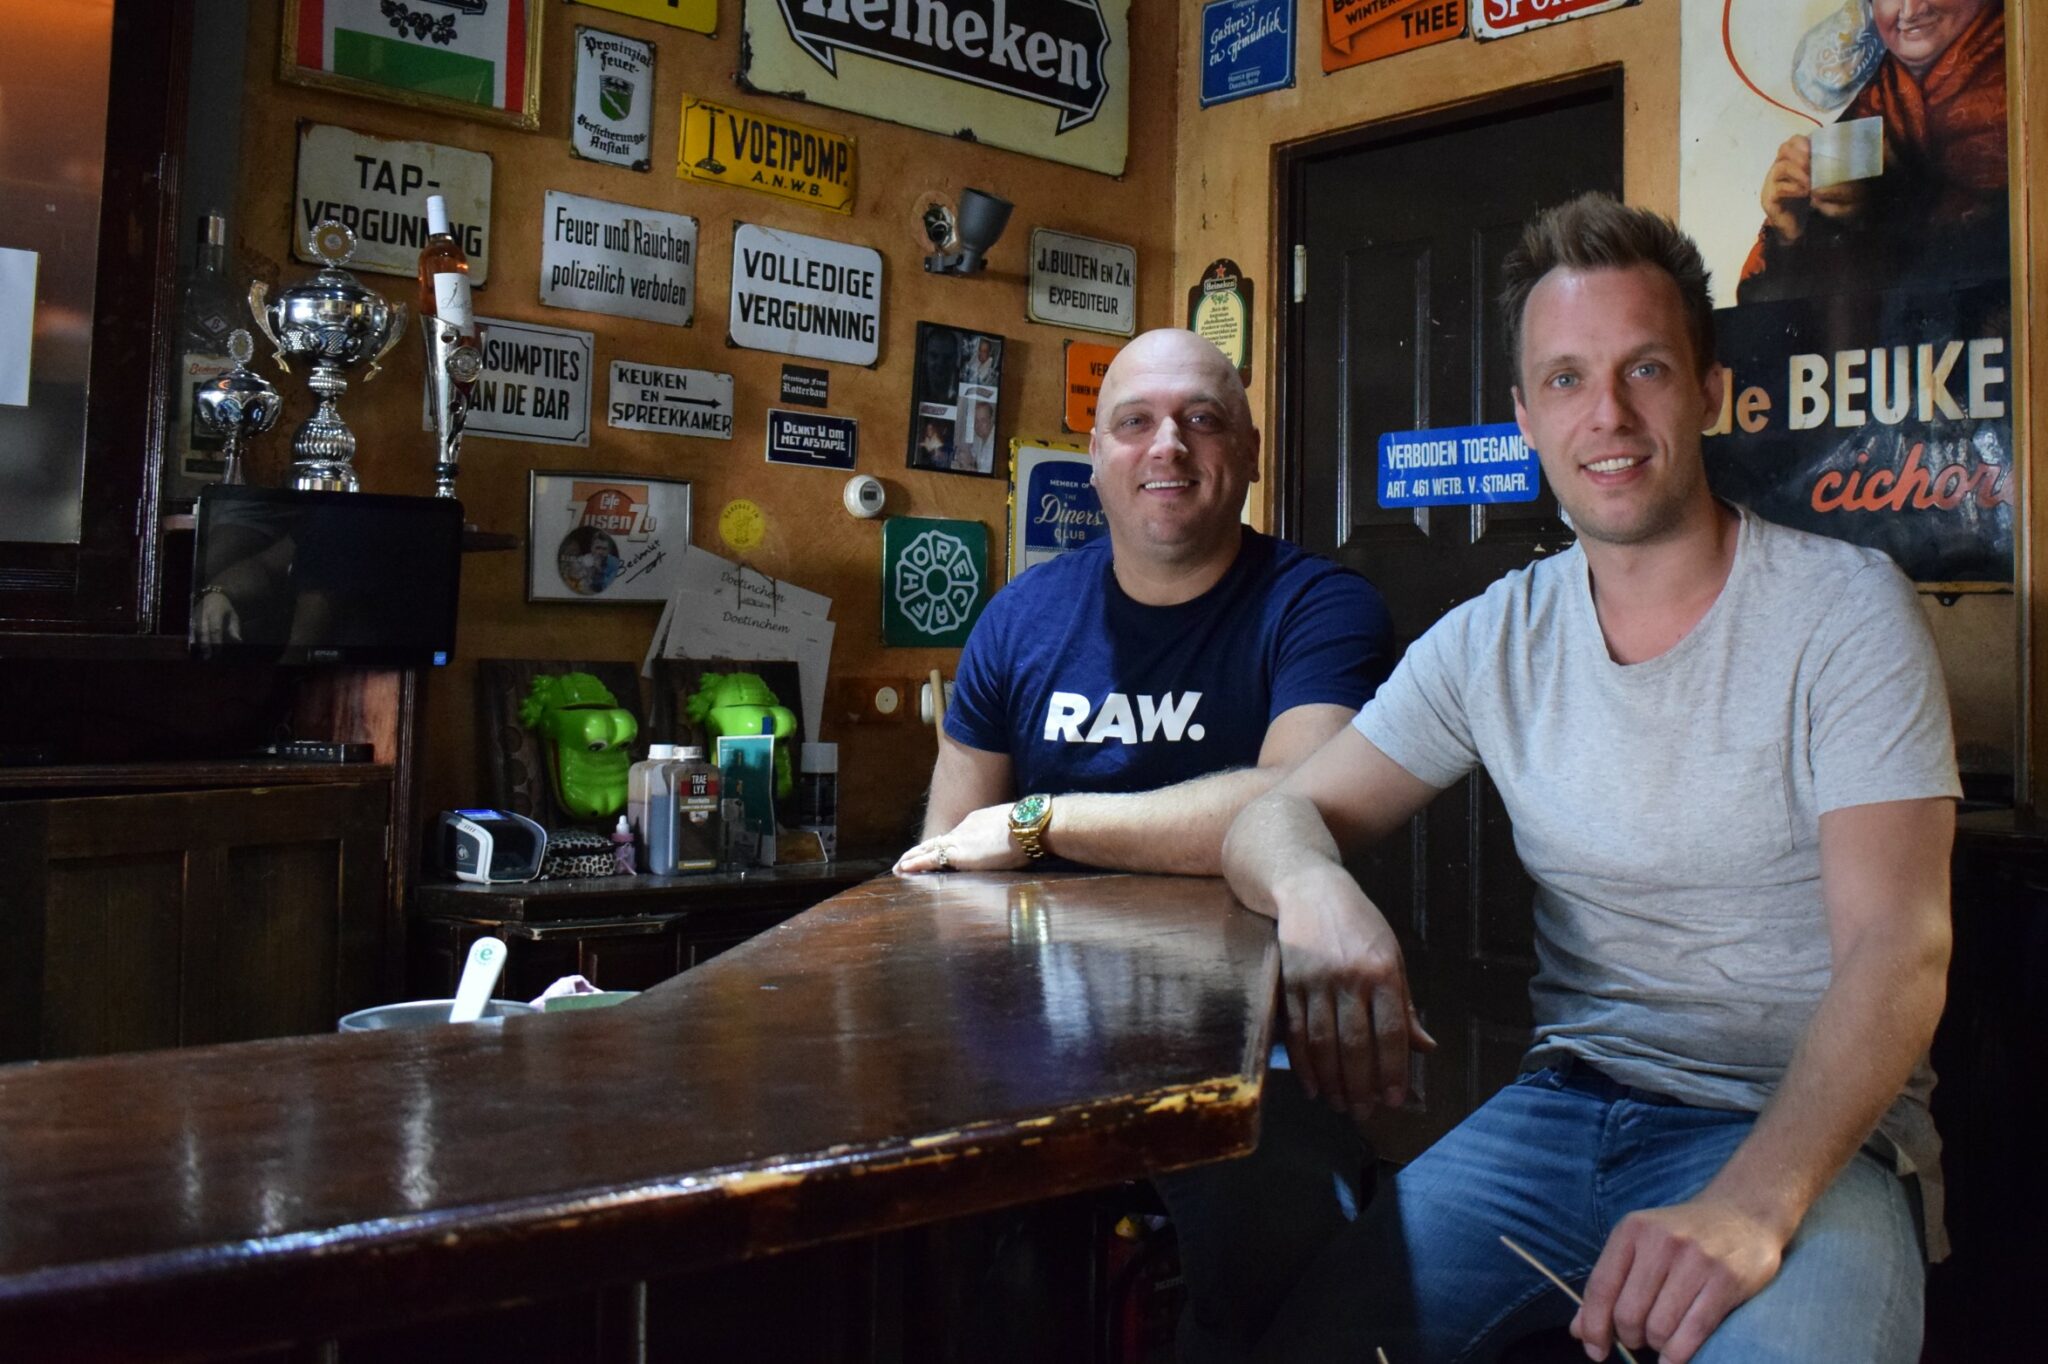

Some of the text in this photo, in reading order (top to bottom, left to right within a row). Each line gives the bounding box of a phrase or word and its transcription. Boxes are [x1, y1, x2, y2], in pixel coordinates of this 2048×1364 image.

[1401, 2, 1458, 39] THEE
[729, 113, 848, 188] VOETPOMP.
[354, 154, 441, 197] TAP-
[752, 170, 823, 198] A.N.W.B.
[303, 198, 482, 258] VERGUNNNG
[555, 206, 690, 266] Feuer und Rauchen
[551, 259, 687, 307] polizeilich verboten
[743, 247, 875, 300] VOLLEDIGE
[1049, 285, 1119, 316] EXPEDITEUR
[738, 291, 876, 344] VERGUNNING
[618, 367, 687, 391] KEUKEN
[782, 382, 827, 398] Rotterdam
[502, 382, 528, 416] DE
[532, 386, 570, 421] BAR
[641, 389, 660, 402] EN
[611, 402, 733, 433] SPREEKKAMER
[781, 434, 846, 452] HET AFSTAPJE
[1386, 434, 1530, 470] VERBODEN TOEGANG
[1049, 479, 1079, 489] MEMBER
[1386, 472, 1529, 499] ART. 461 WETB. V. STRAFR.
[1054, 527, 1086, 541] CLUB
[720, 570, 786, 603] Doetinchem
[722, 610, 791, 634] Doetinchem
[1043, 690, 1206, 745] RAW.
[692, 784, 706, 795] LYX
